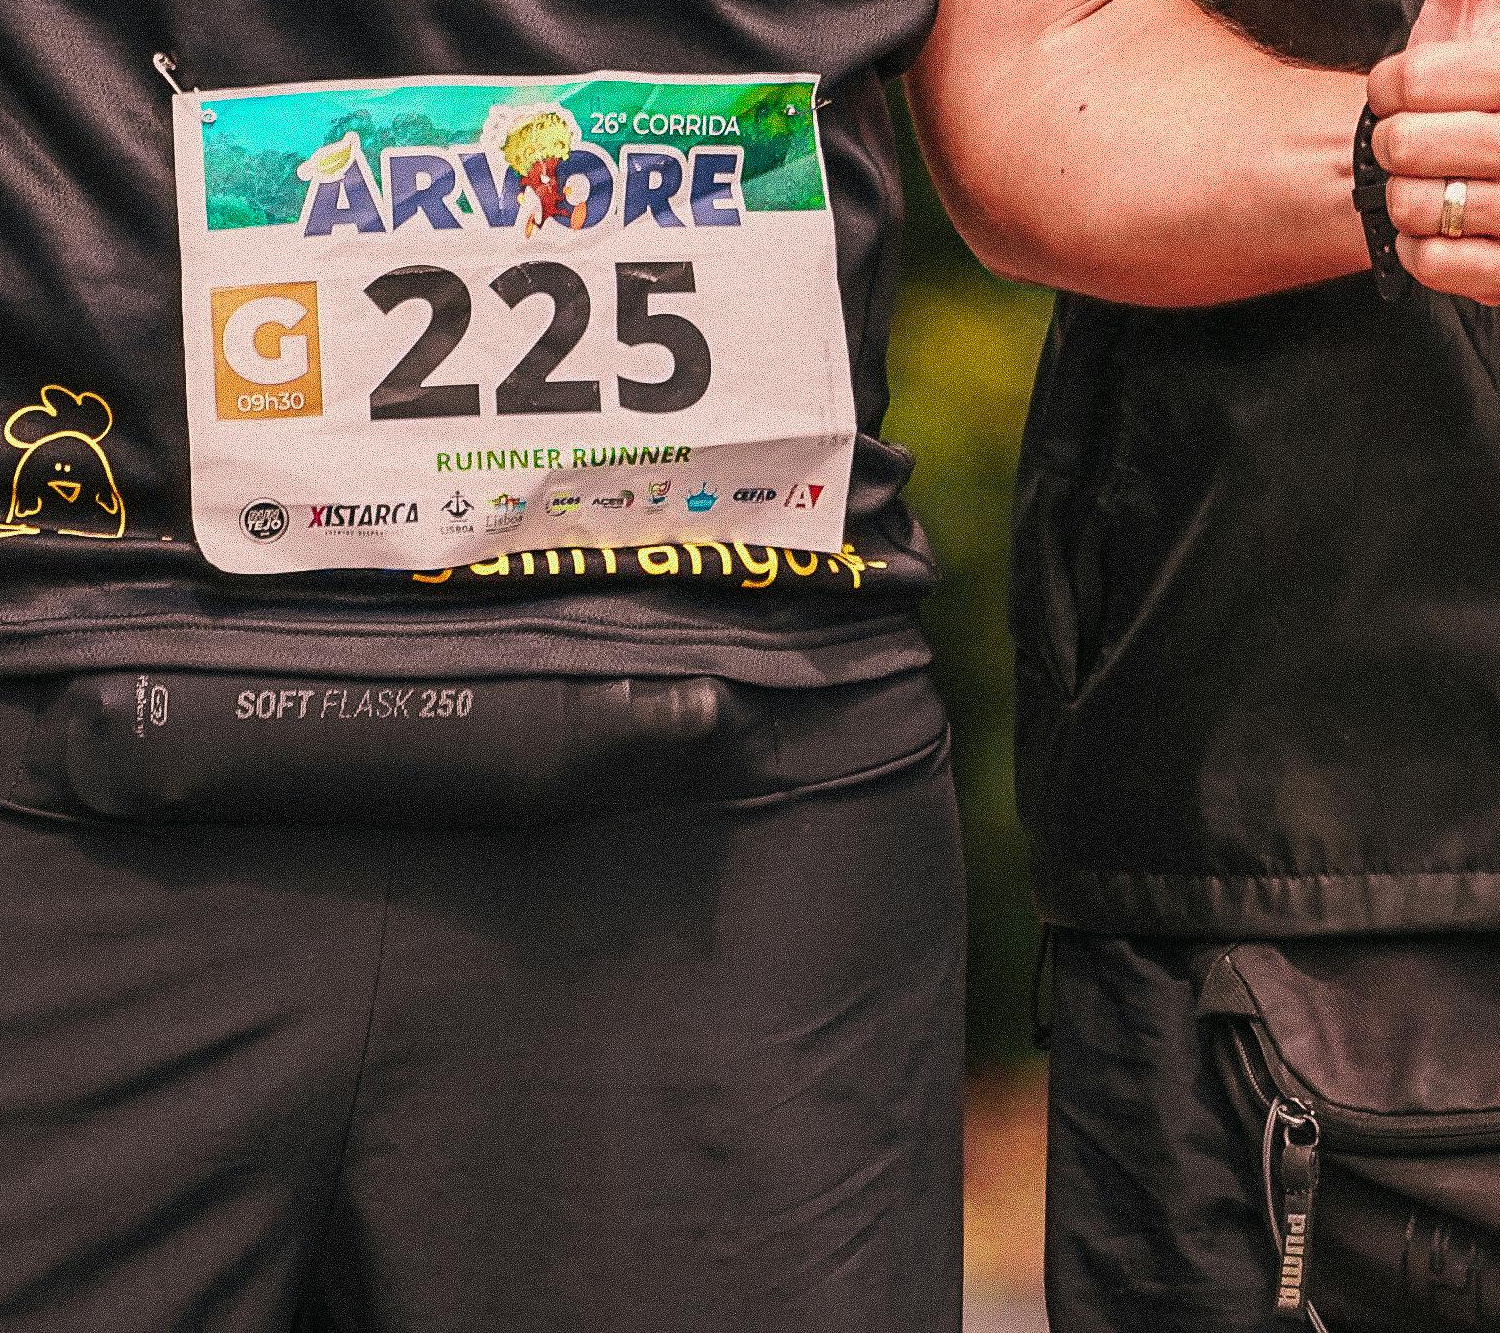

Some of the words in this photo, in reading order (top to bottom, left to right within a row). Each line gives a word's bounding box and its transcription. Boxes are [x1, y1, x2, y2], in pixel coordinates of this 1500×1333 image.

[590, 111, 629, 136] 26ª
[634, 111, 741, 137] CORRIDA
[223, 297, 310, 386] G
[364, 260, 712, 422] 225
[237, 392, 305, 413] 09h30
[436, 448, 563, 472] RUINNER
[571, 444, 692, 470] RUINNER
[732, 488, 777, 503] CEFAD
[308, 502, 419, 529] XISTARCA
[235, 689, 315, 720] SOFT
[320, 689, 415, 719] FLASK
[418, 688, 475, 718] 250
